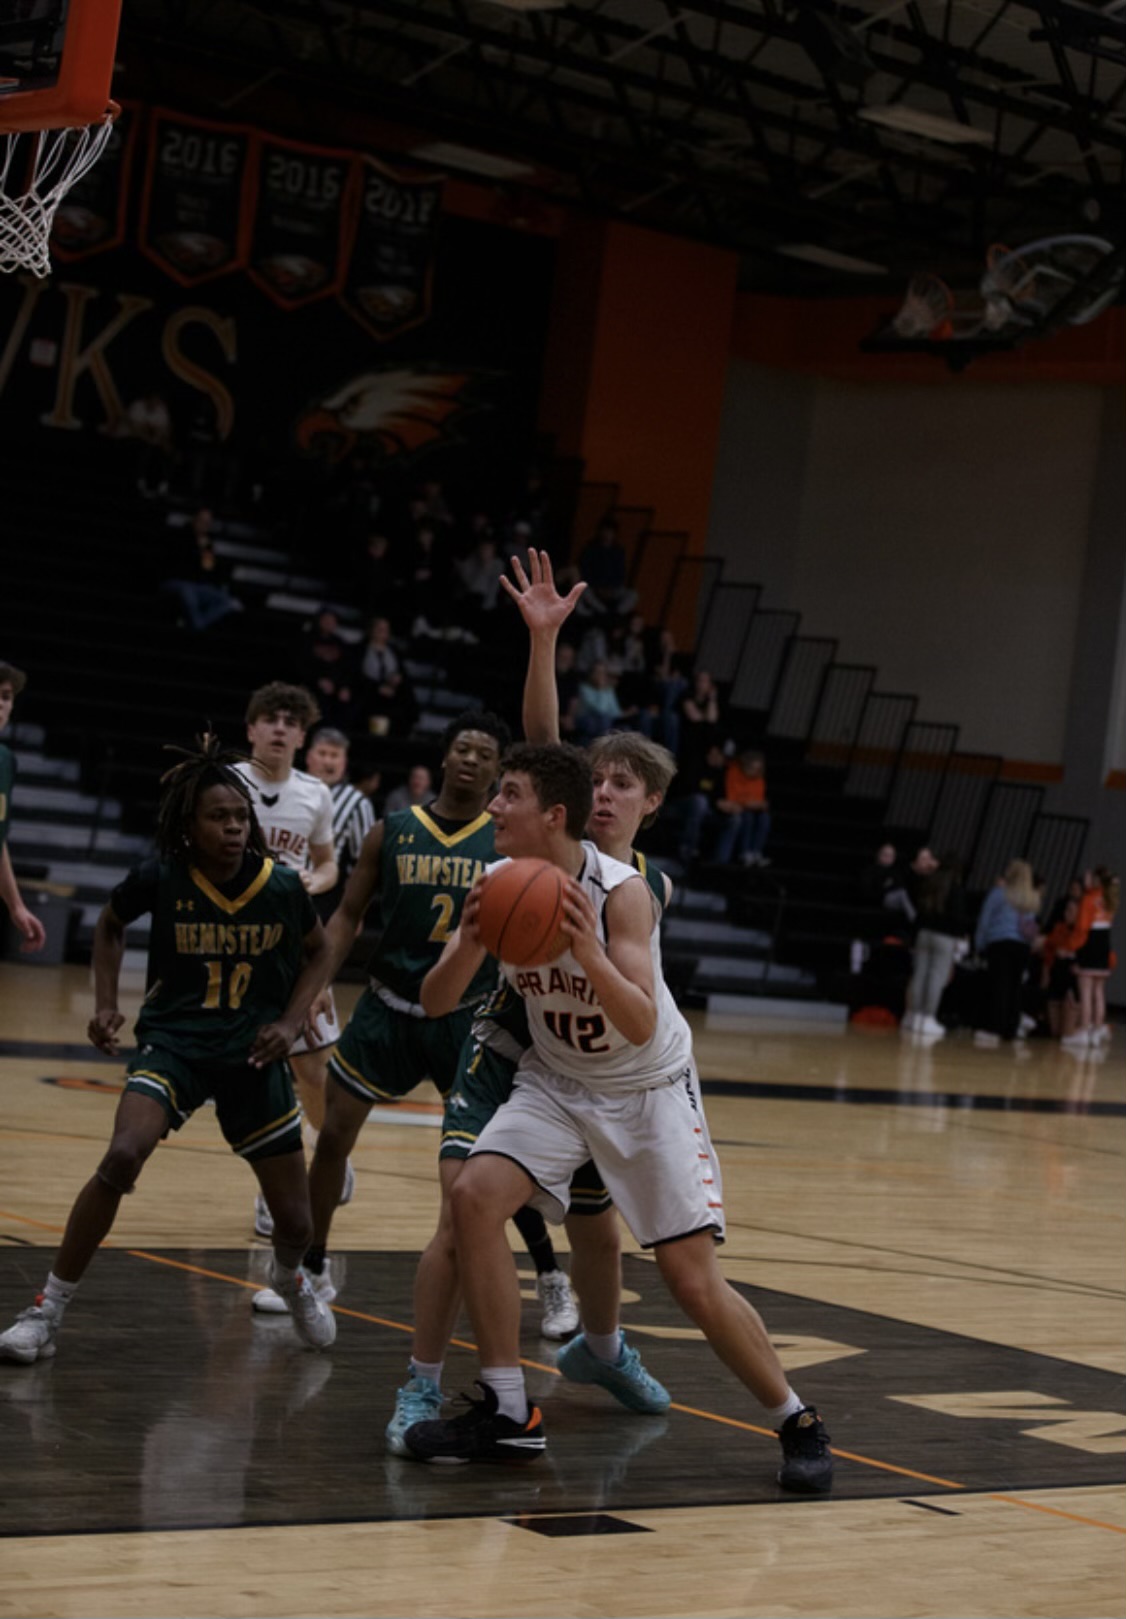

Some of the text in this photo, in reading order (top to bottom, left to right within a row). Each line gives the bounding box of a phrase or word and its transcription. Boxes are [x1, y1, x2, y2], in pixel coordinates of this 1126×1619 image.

[0, 276, 238, 442] KS
[396, 853, 484, 889] HEMPSTEA
[426, 892, 461, 944] 2
[200, 960, 254, 1010] 10
[543, 1011, 610, 1053] 42
